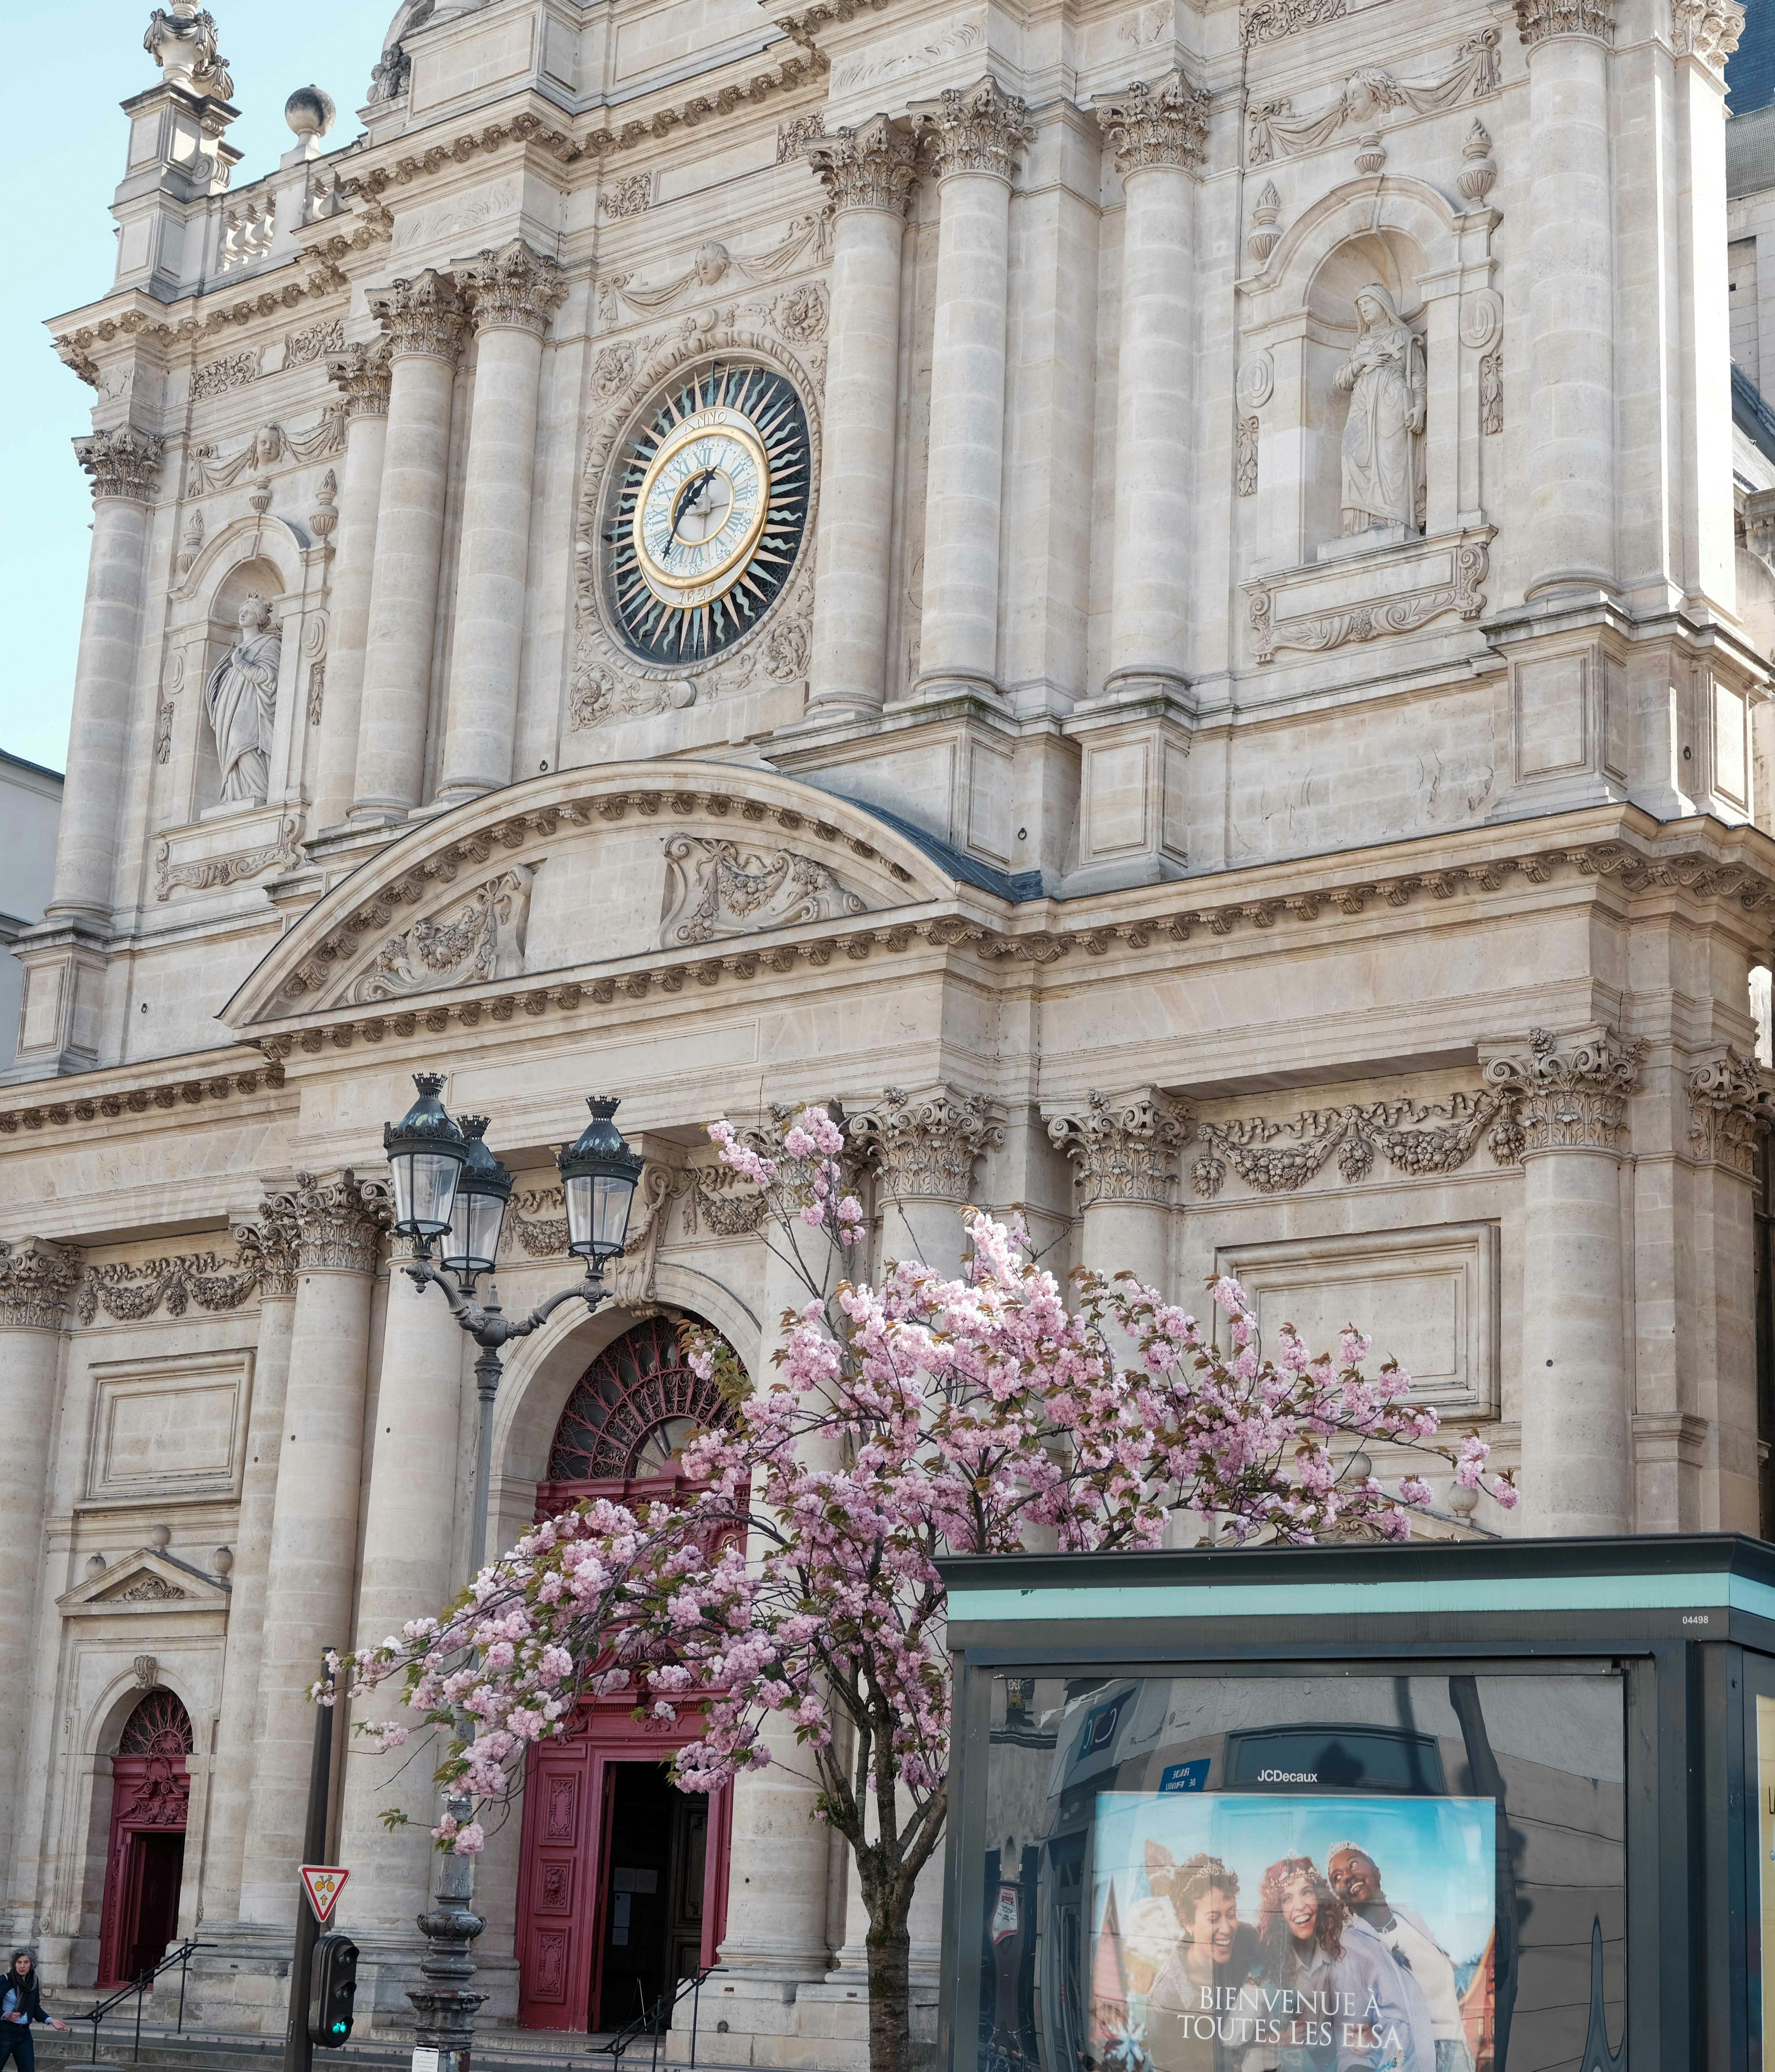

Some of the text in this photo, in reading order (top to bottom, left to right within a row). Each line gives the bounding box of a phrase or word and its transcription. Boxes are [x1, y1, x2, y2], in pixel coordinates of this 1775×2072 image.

[684, 410, 727, 431] ANNO
[692, 447, 713, 469] XII
[672, 458, 692, 483] XI
[729, 461, 745, 483] II
[657, 481, 677, 502] X
[734, 483, 748, 504] III
[652, 507, 669, 527] IX
[689, 546, 705, 564] VI
[715, 536, 726, 553] V
[677, 583, 715, 604] 1627
[1682, 1616, 1708, 1624] 04498
[1258, 1770, 1317, 1782] JCDecaux
[1199, 1986, 1383, 2017] BIENVENUE À
[1177, 2015, 1403, 2049] TOUTES LES ELSA
